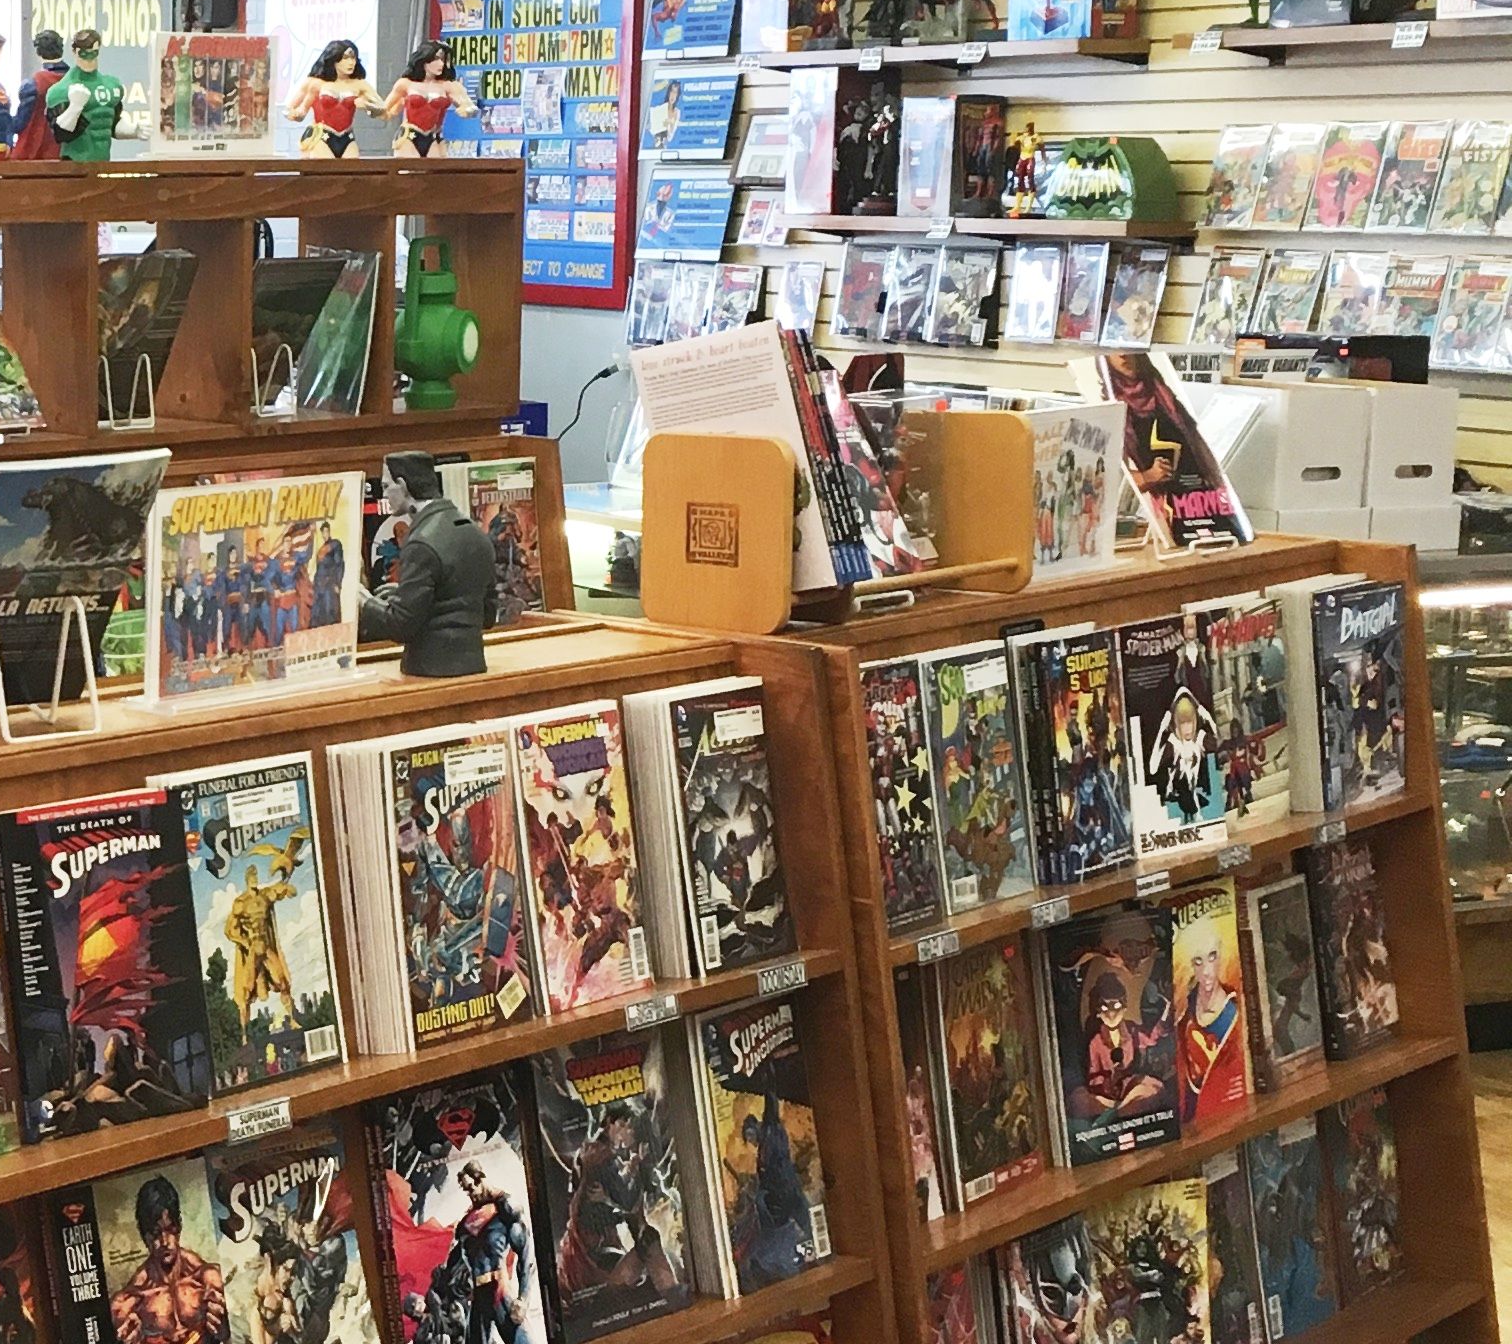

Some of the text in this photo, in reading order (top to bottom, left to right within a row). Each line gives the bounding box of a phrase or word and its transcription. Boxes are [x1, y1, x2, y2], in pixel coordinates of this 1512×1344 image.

[308, 10, 348, 40] HERE!
[490, 0, 504, 30] IN
[446, 35, 499, 66] MARCH
[503, 33, 513, 64] 5
[484, 68, 522, 99] FCBD
[566, 66, 602, 97] MAY
[1463, 149, 1501, 163] FIST
[548, 262, 562, 277] TO
[565, 261, 606, 279] CHANGE
[169, 480, 344, 536] SUPERMAN FAMILY
[1340, 593, 1397, 645] BATGIRL
[1125, 631, 1185, 657] SPIDER-MAN
[1065, 649, 1109, 673] SUICIDE
[198, 777, 238, 796] FUNERAL
[238, 774, 257, 789] FOR
[258, 772, 264, 785] A
[57, 814, 132, 834] THE DEATH OF
[214, 814, 301, 879] SUPERMAN
[51, 834, 161, 899] SUPERMAN
[416, 999, 467, 1034] BUSTING
[470, 993, 495, 1020] OUT!
[583, 1077, 644, 1106] WOMAN
[240, 1106, 280, 1125] SUPERMAN
[231, 1123, 255, 1139] DEATH
[230, 1156, 341, 1242] SUPERMAN
[62, 1223, 92, 1247] EARTH
[66, 1241, 97, 1274] ONE
[71, 1283, 101, 1303] THREE
